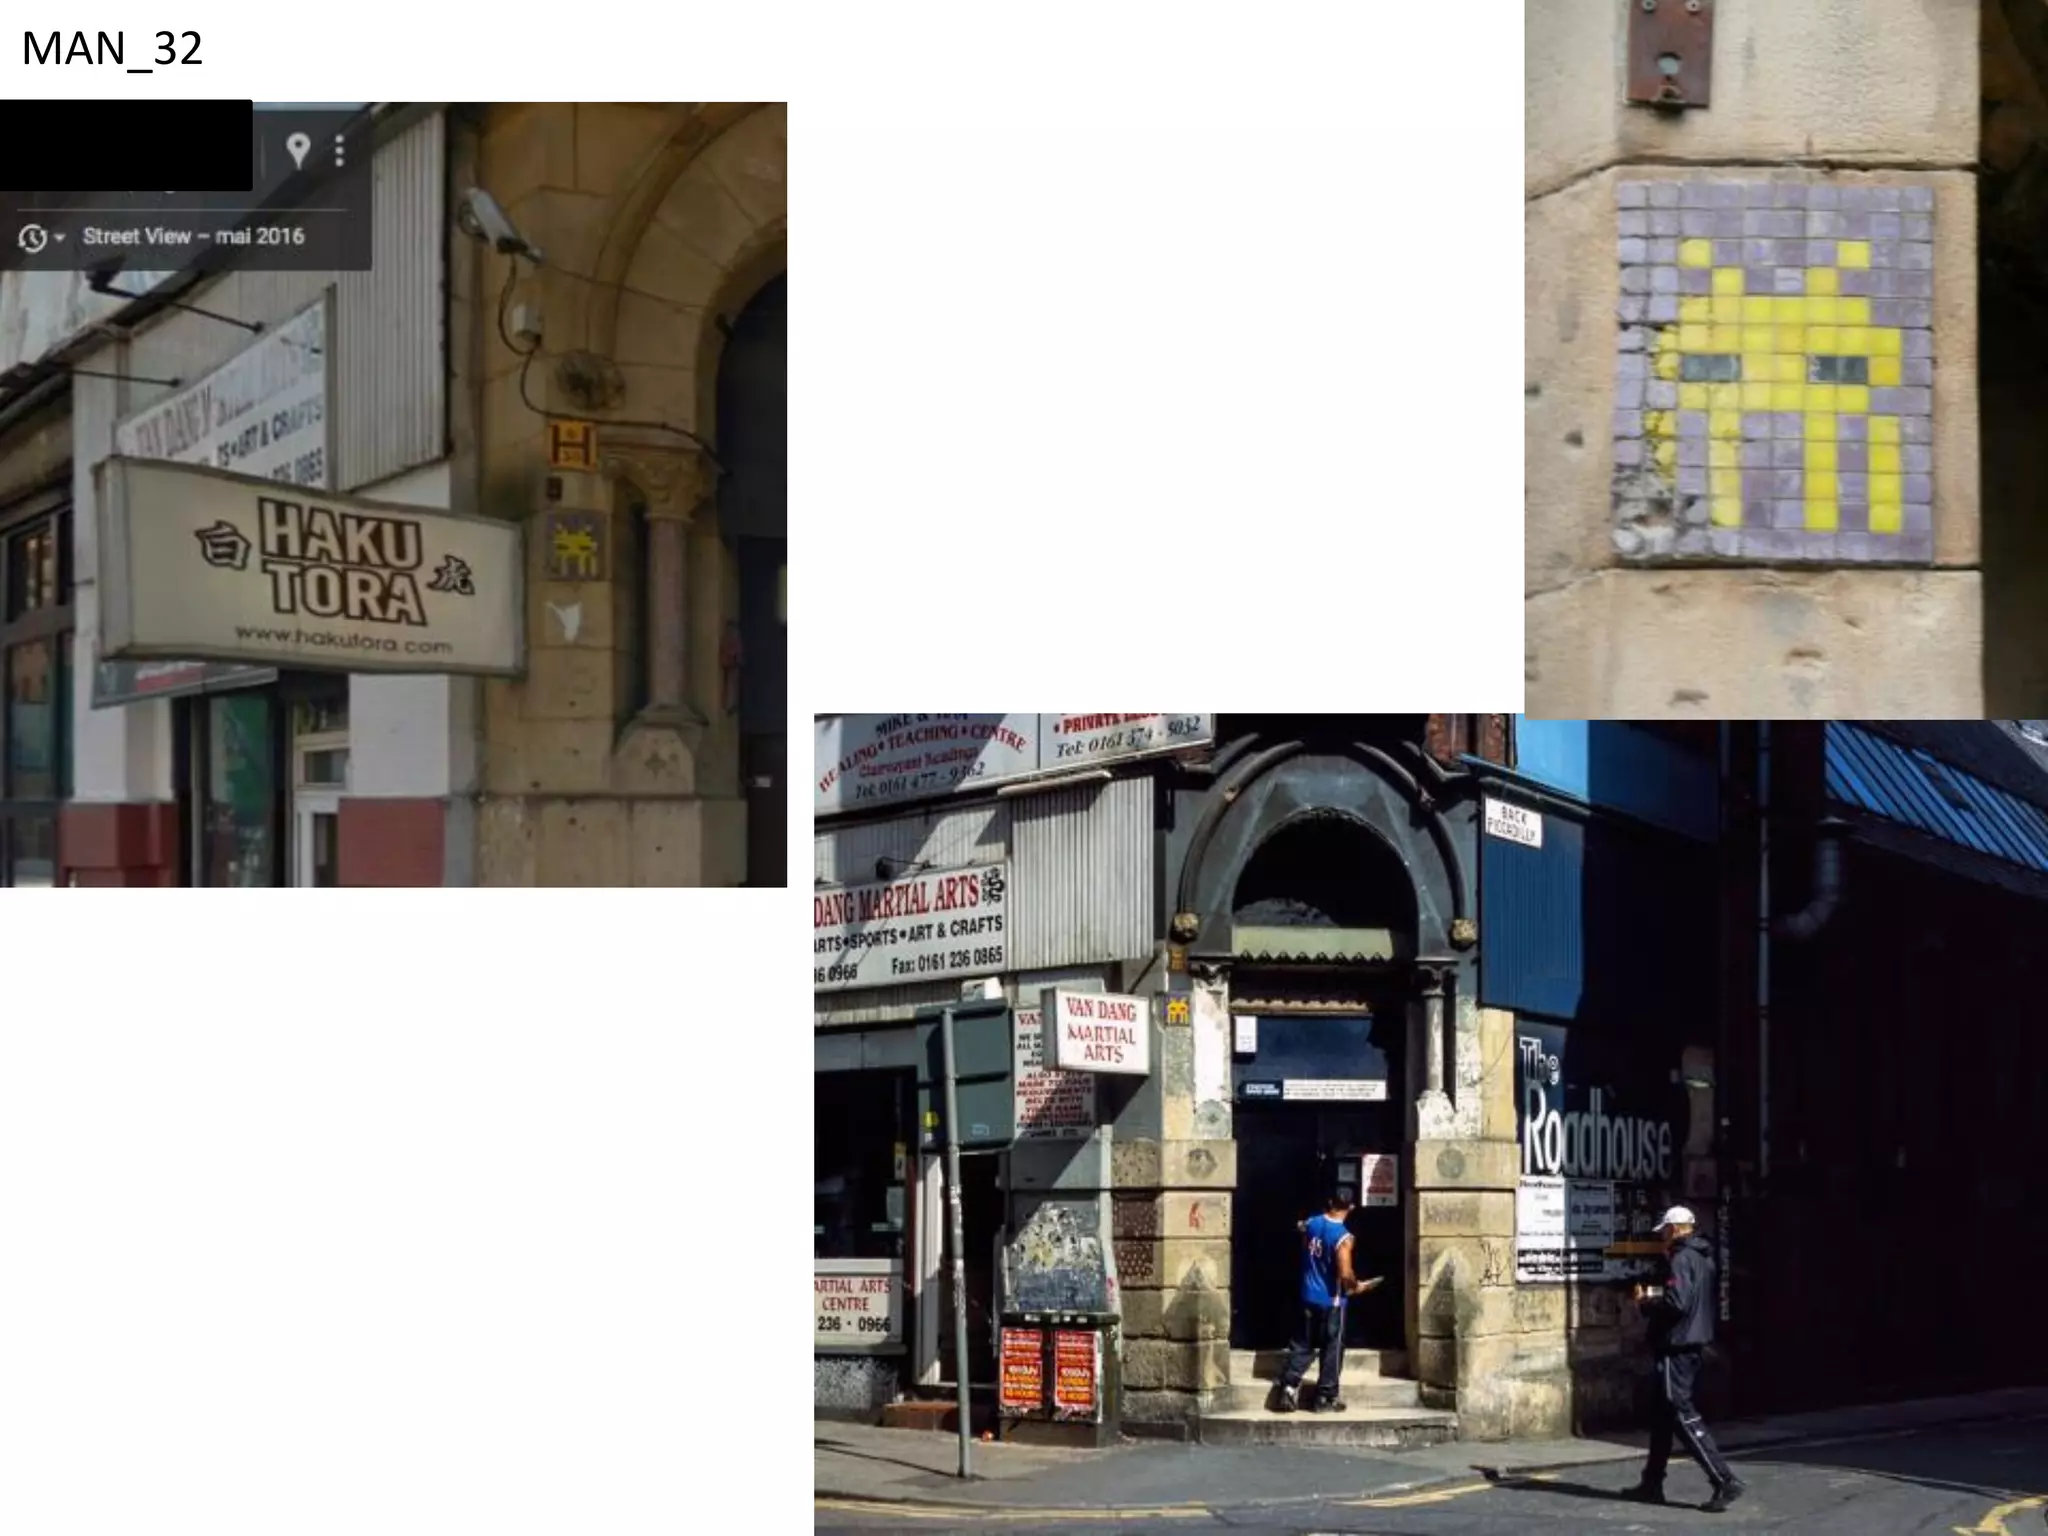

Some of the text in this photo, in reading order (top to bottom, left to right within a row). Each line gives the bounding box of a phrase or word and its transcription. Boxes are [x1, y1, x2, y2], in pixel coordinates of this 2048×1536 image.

[257, 496, 423, 572] HAKU
[261, 558, 428, 627] TORA
[235, 624, 453, 655] www.hakutora.com
[1063, 713, 1121, 734] PRIVATE
[887, 724, 958, 750] TEACHING
[970, 723, 1027, 753] CENTRE
[814, 874, 980, 928] DANG MARTIAL ARTS
[937, 922, 947, 938] &
[950, 915, 1003, 937] CRAFTS
[892, 958, 915, 975] Fax:
[918, 952, 945, 973] 0161
[949, 950, 971, 969] 236
[1066, 996, 1137, 1023] VAN DANG
[1067, 1023, 1137, 1045] MARTIAL
[1084, 1044, 1125, 1064] ARTS
[1519, 1036, 1561, 1086] The
[1523, 1079, 1673, 1180] Roadhouse
[860, 1277, 893, 1294] ARTS
[822, 1296, 870, 1312] CENTRE
[818, 1315, 841, 1332] 236
